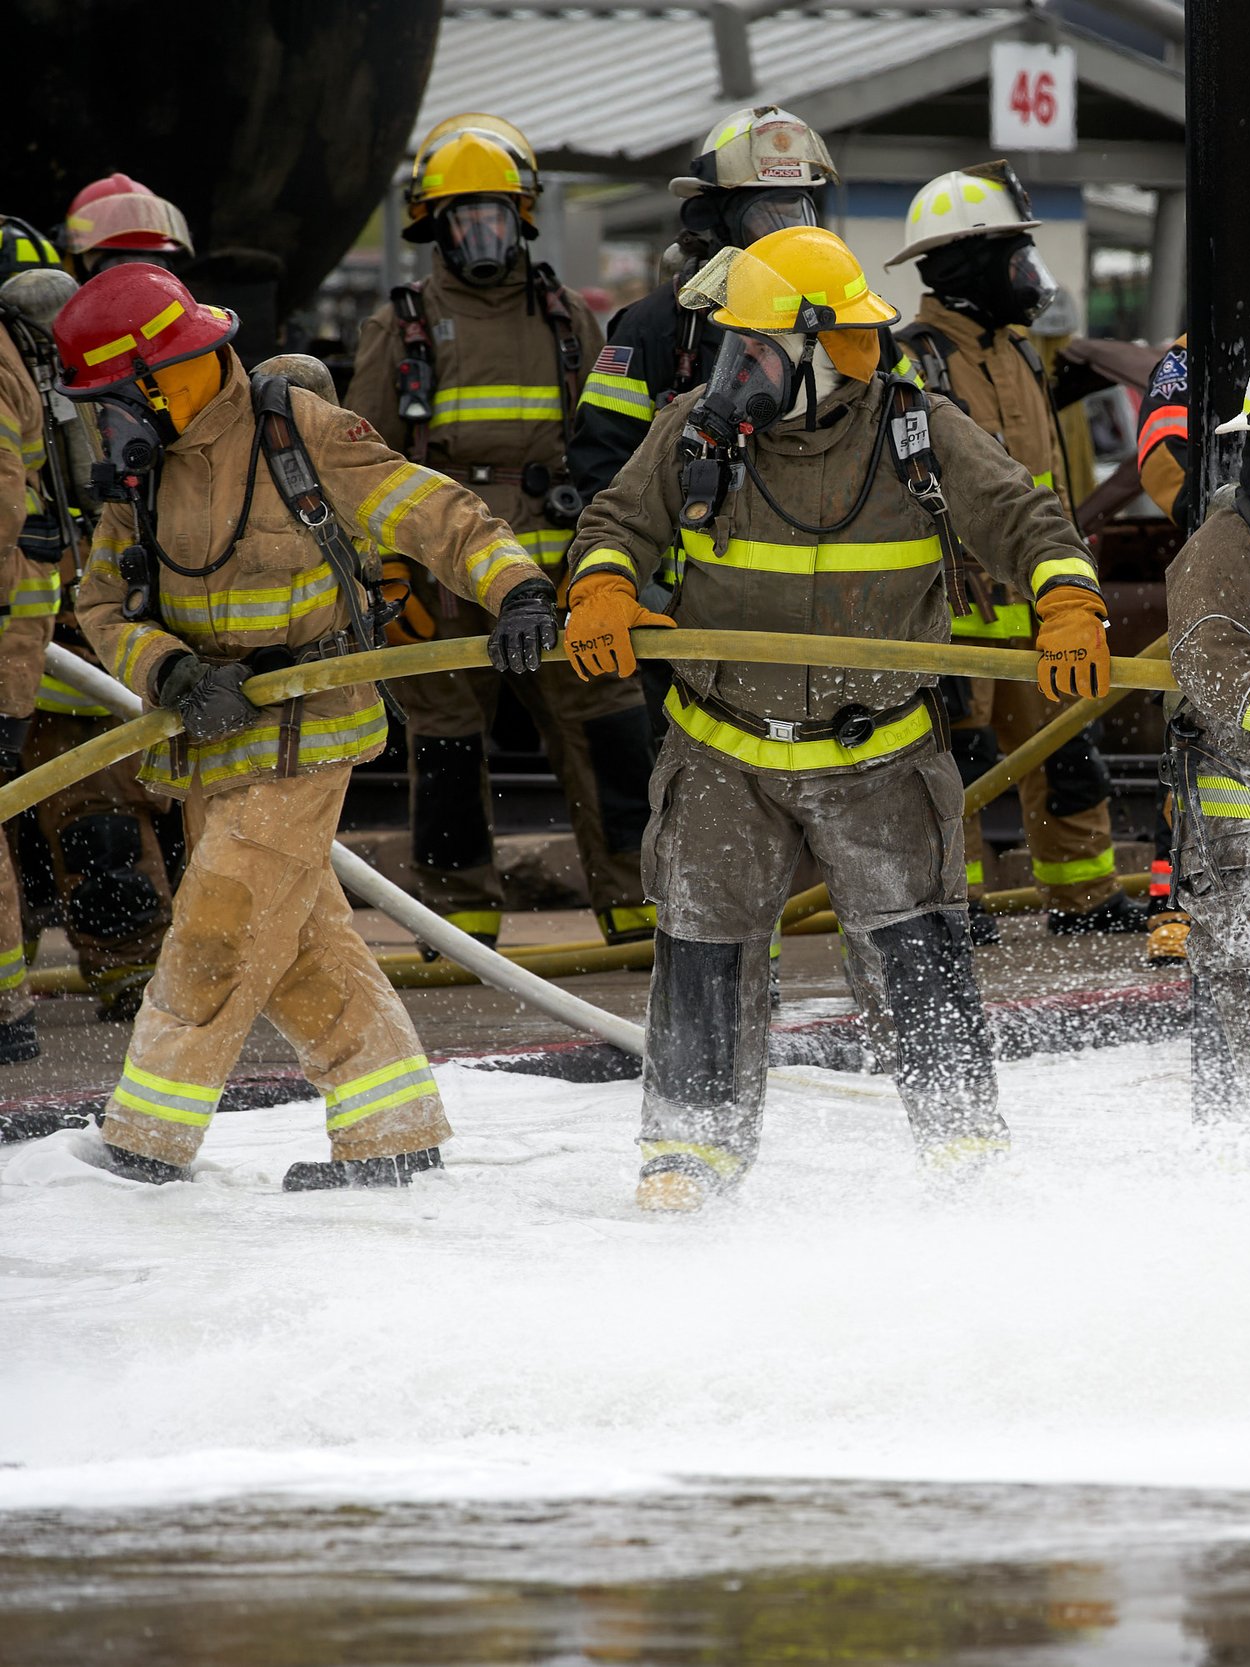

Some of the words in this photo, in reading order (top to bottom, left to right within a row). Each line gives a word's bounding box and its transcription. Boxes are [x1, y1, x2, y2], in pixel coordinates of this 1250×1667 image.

[1010, 70, 1056, 126] 46
[763, 169, 800, 177] JACKSON
[901, 430, 926, 447] SOTT
